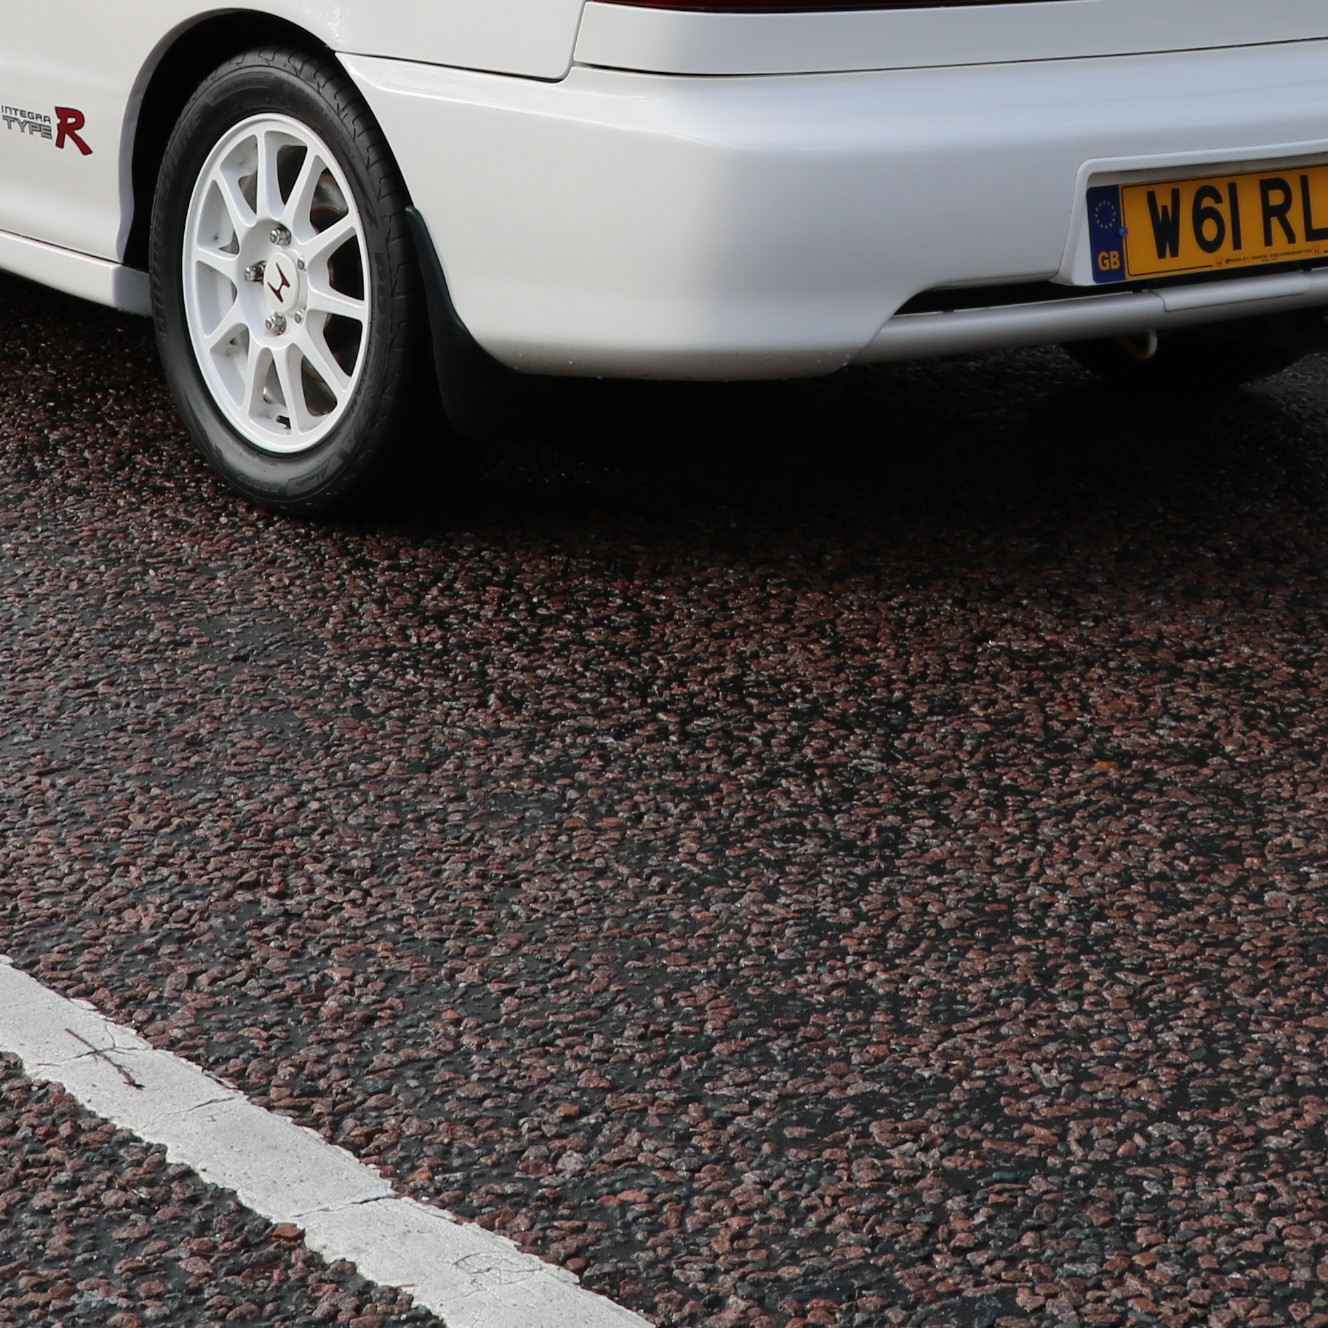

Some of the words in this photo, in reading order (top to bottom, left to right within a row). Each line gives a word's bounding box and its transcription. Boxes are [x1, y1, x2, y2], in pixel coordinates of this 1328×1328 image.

[1, 105, 51, 124] INTEGRA
[2, 115, 53, 140] TYPE
[54, 105, 93, 155] R
[1146, 182, 1242, 260] W61
[1097, 250, 1121, 271] GB
